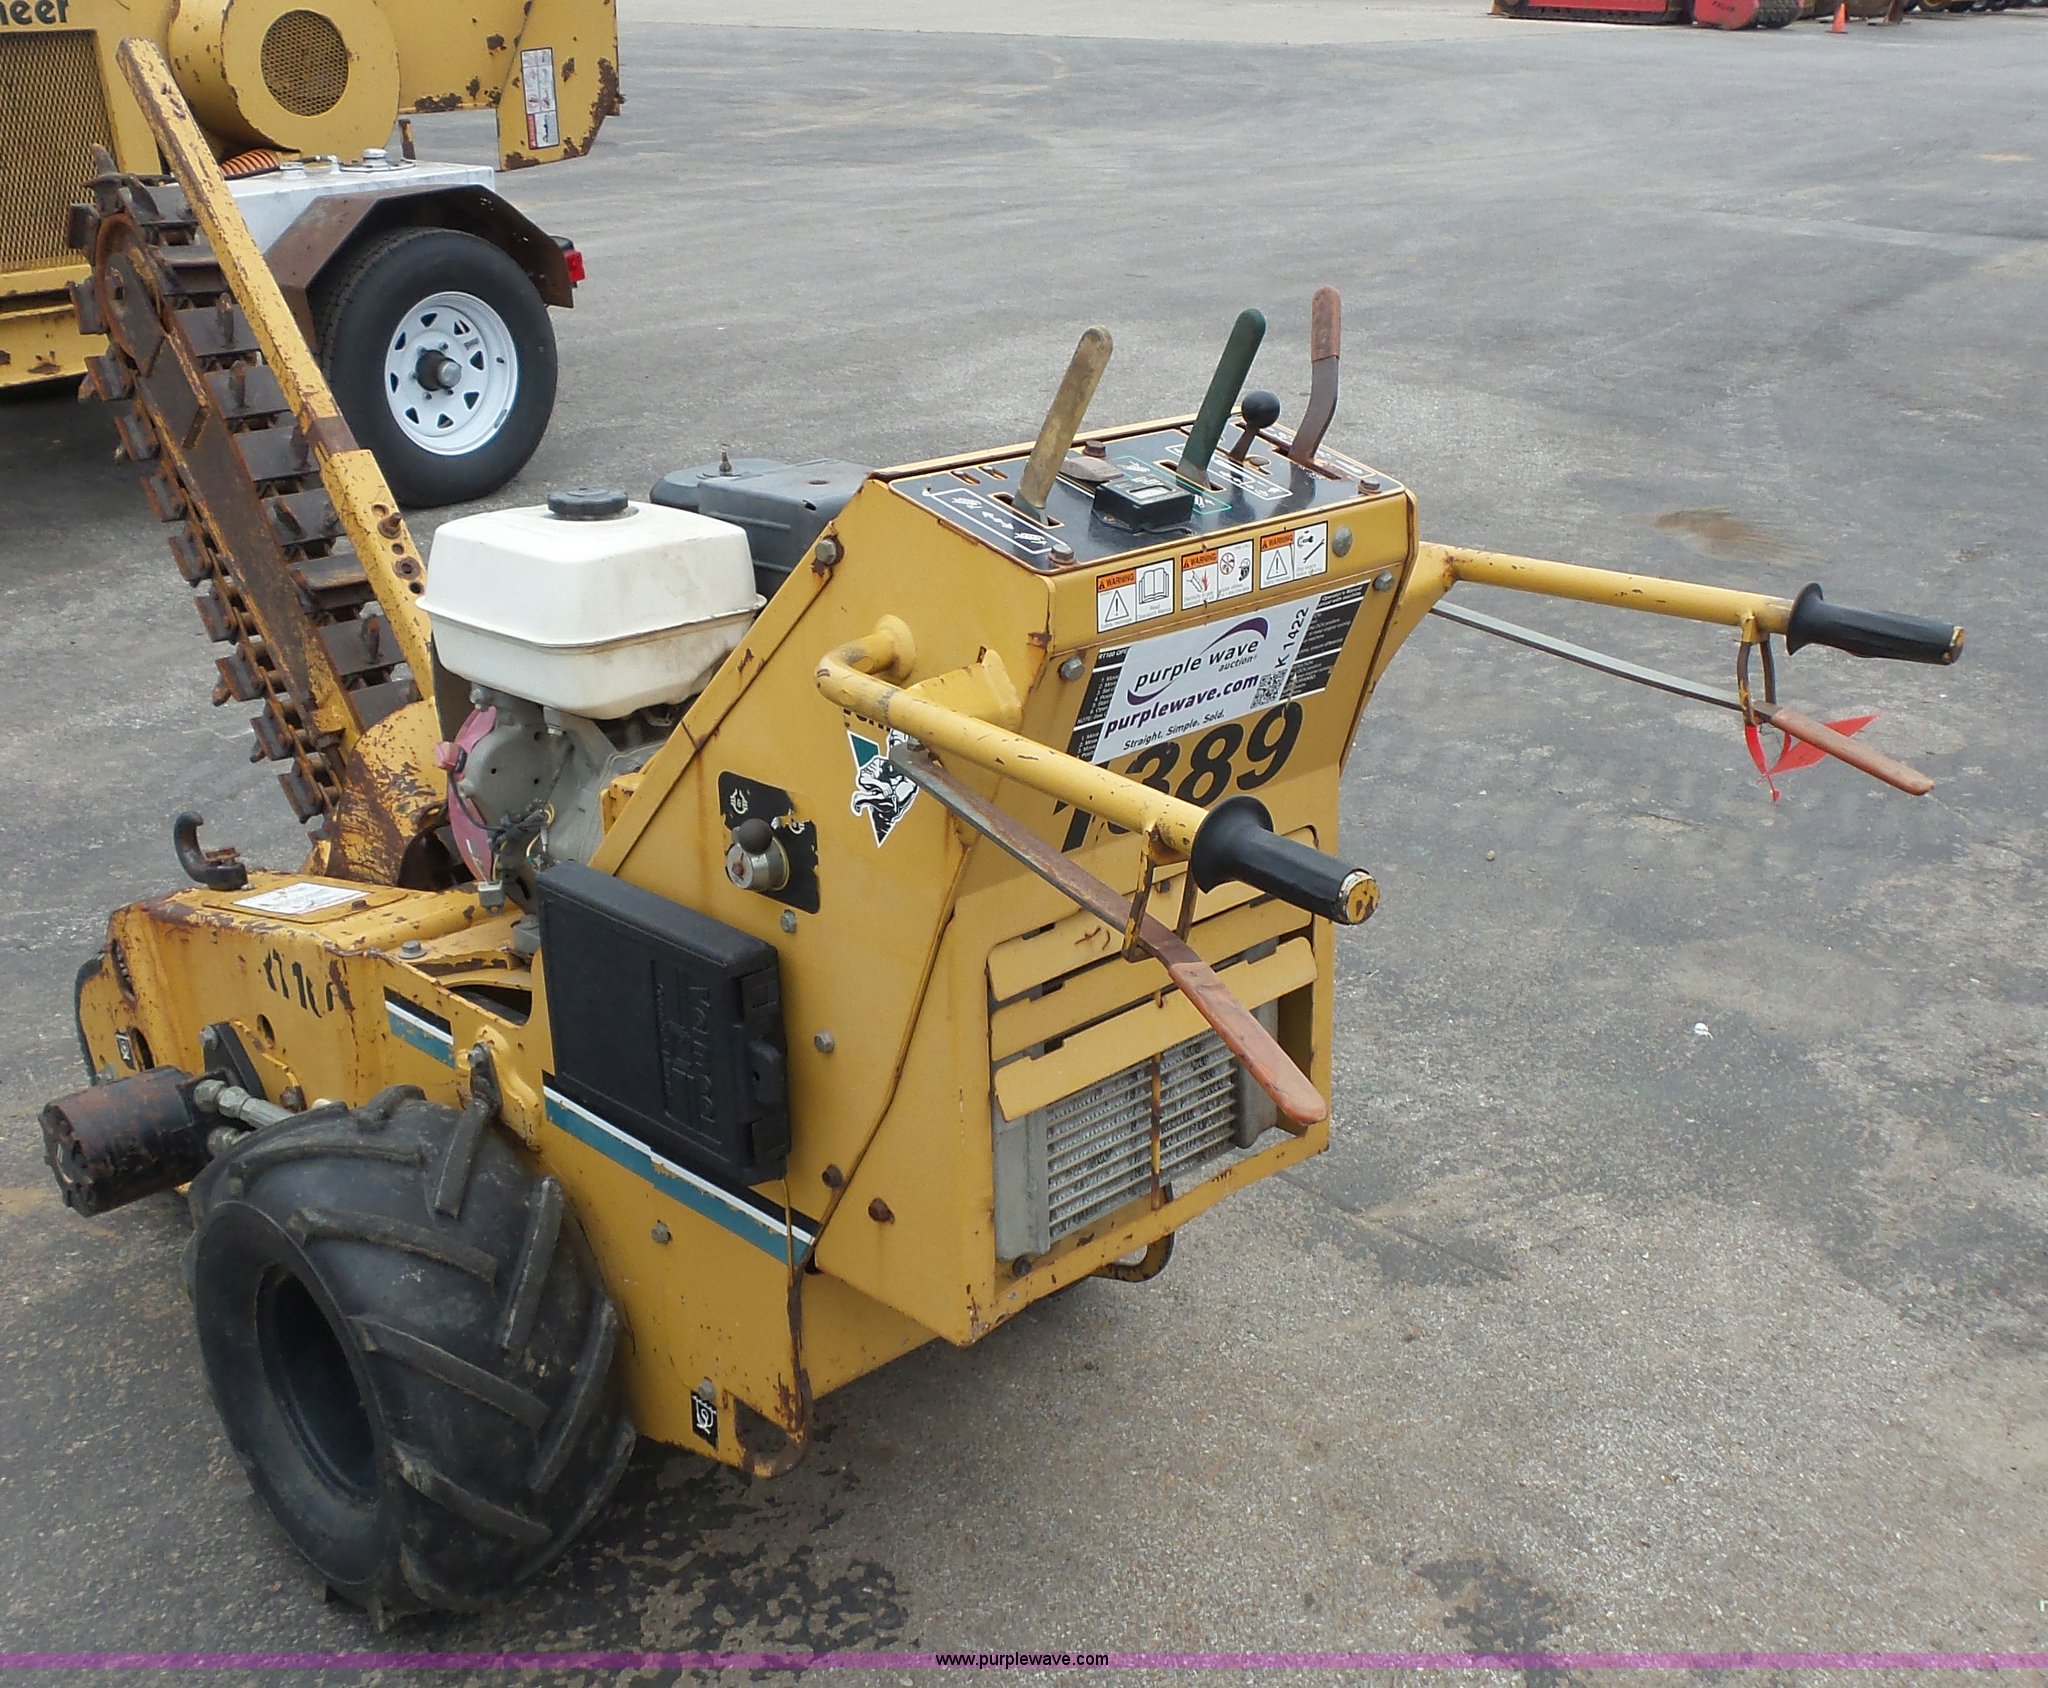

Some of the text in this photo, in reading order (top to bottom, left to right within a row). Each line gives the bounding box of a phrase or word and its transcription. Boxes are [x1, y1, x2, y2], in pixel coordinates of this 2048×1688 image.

[1268, 532, 1294, 547] WARNING
[1189, 551, 1217, 567] WARNING
[1106, 573, 1135, 587] WARNING
[1133, 638, 1259, 692] purple wave
[1104, 674, 1260, 739] purplewave.com
[1123, 709, 1225, 750] Straight. Simple. Sold.
